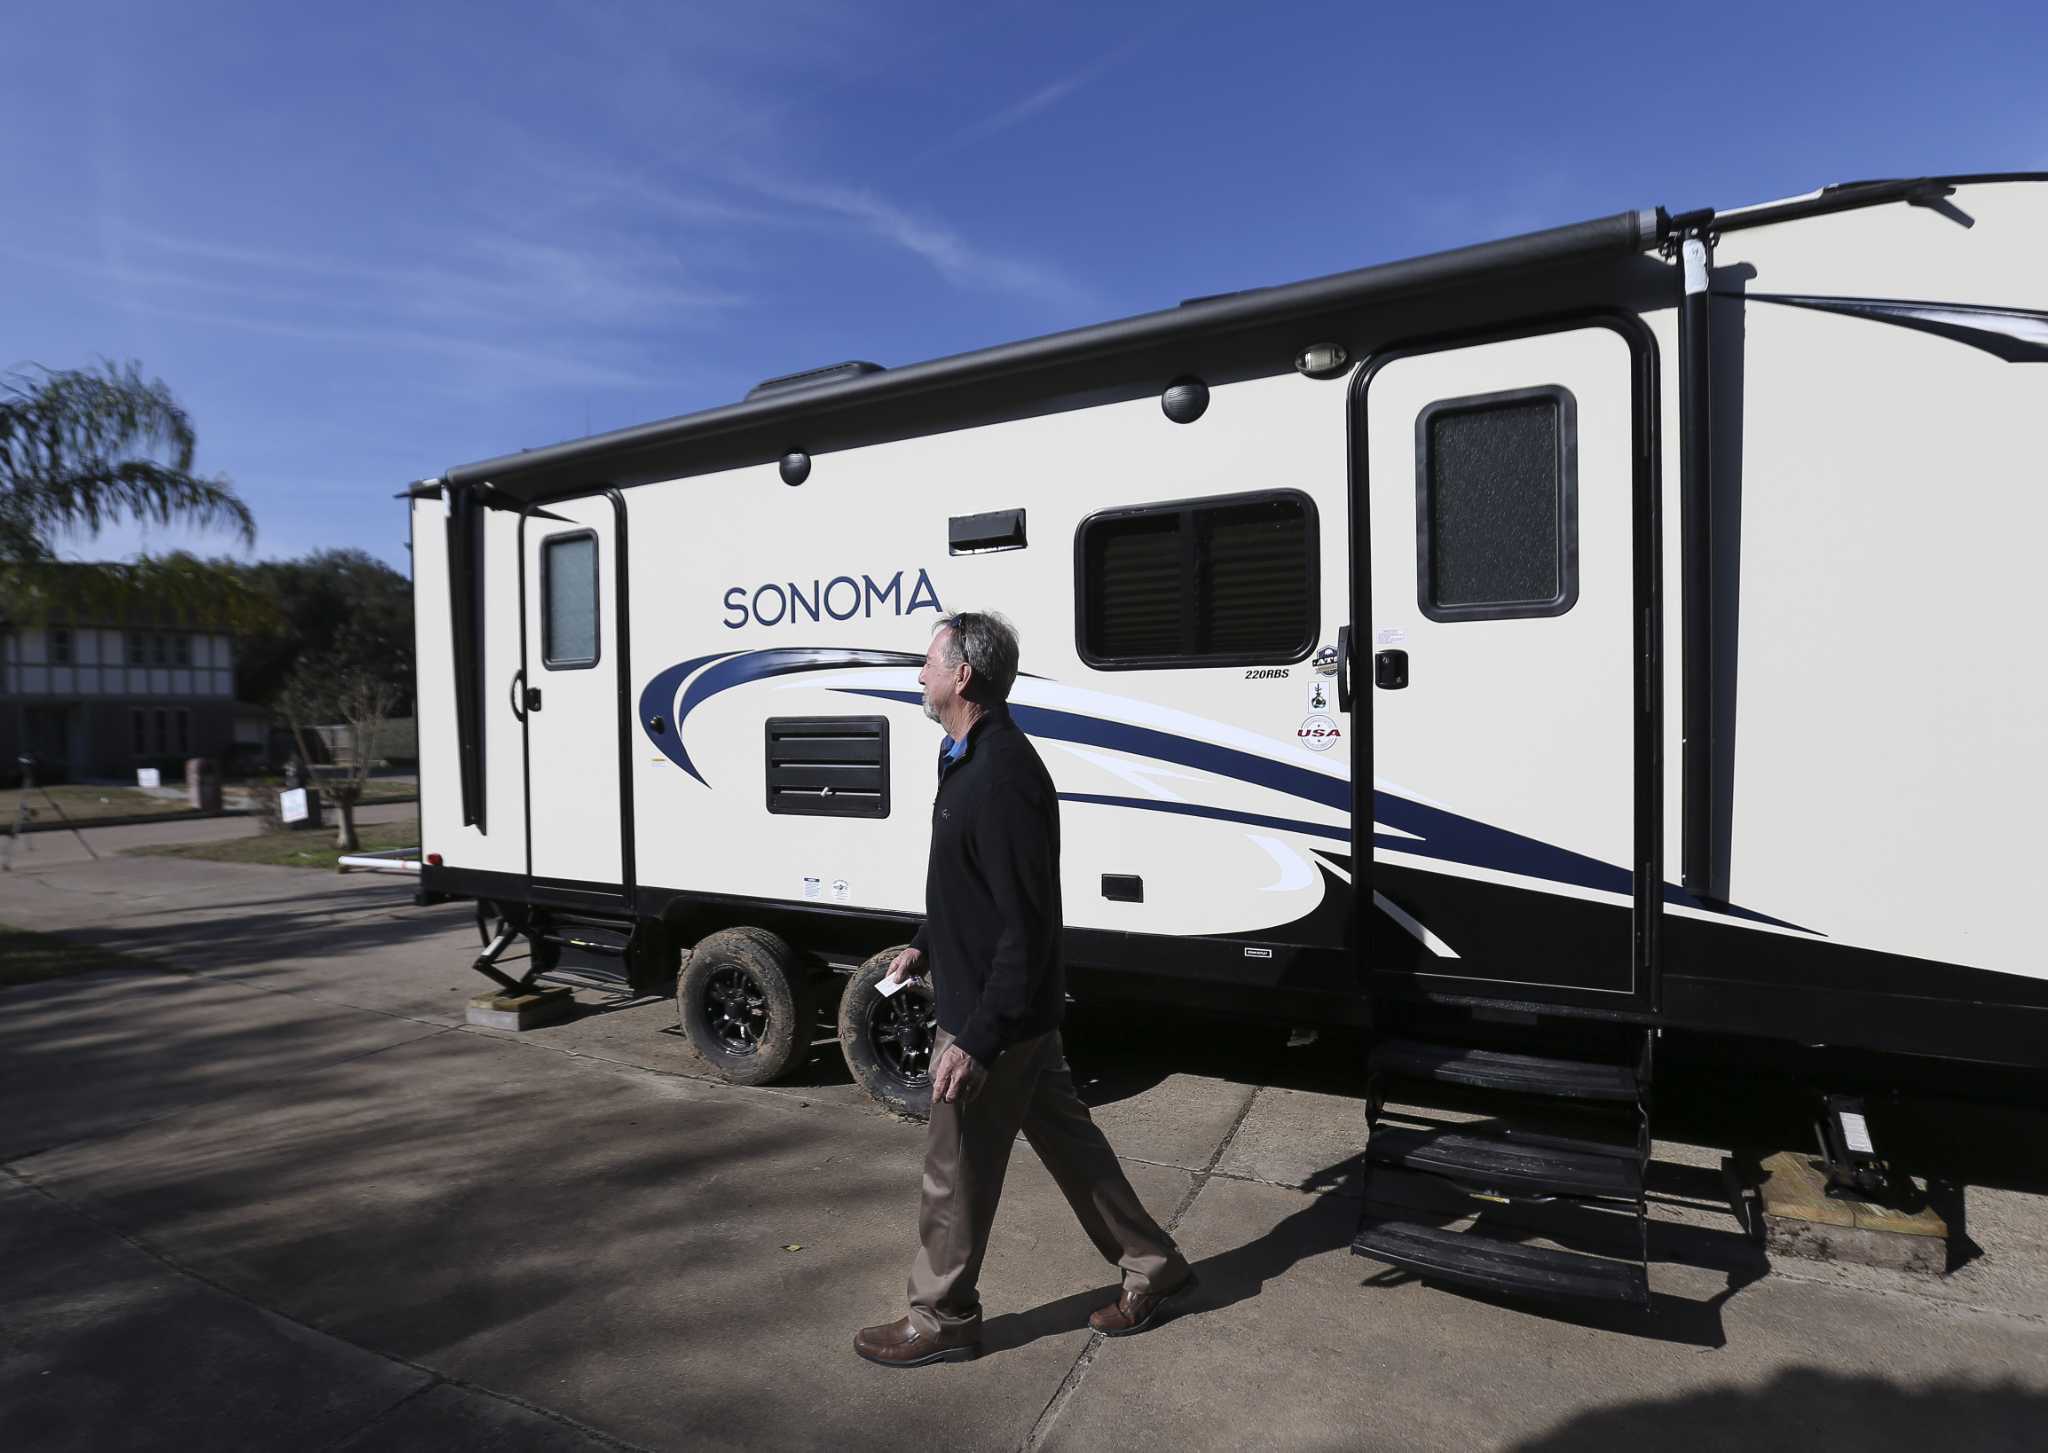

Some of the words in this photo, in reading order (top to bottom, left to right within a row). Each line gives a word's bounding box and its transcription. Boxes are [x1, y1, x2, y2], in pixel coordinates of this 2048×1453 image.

[723, 568, 943, 629] SONOMA
[1245, 669, 1290, 679] 220RBS
[1297, 728, 1342, 737] USA
